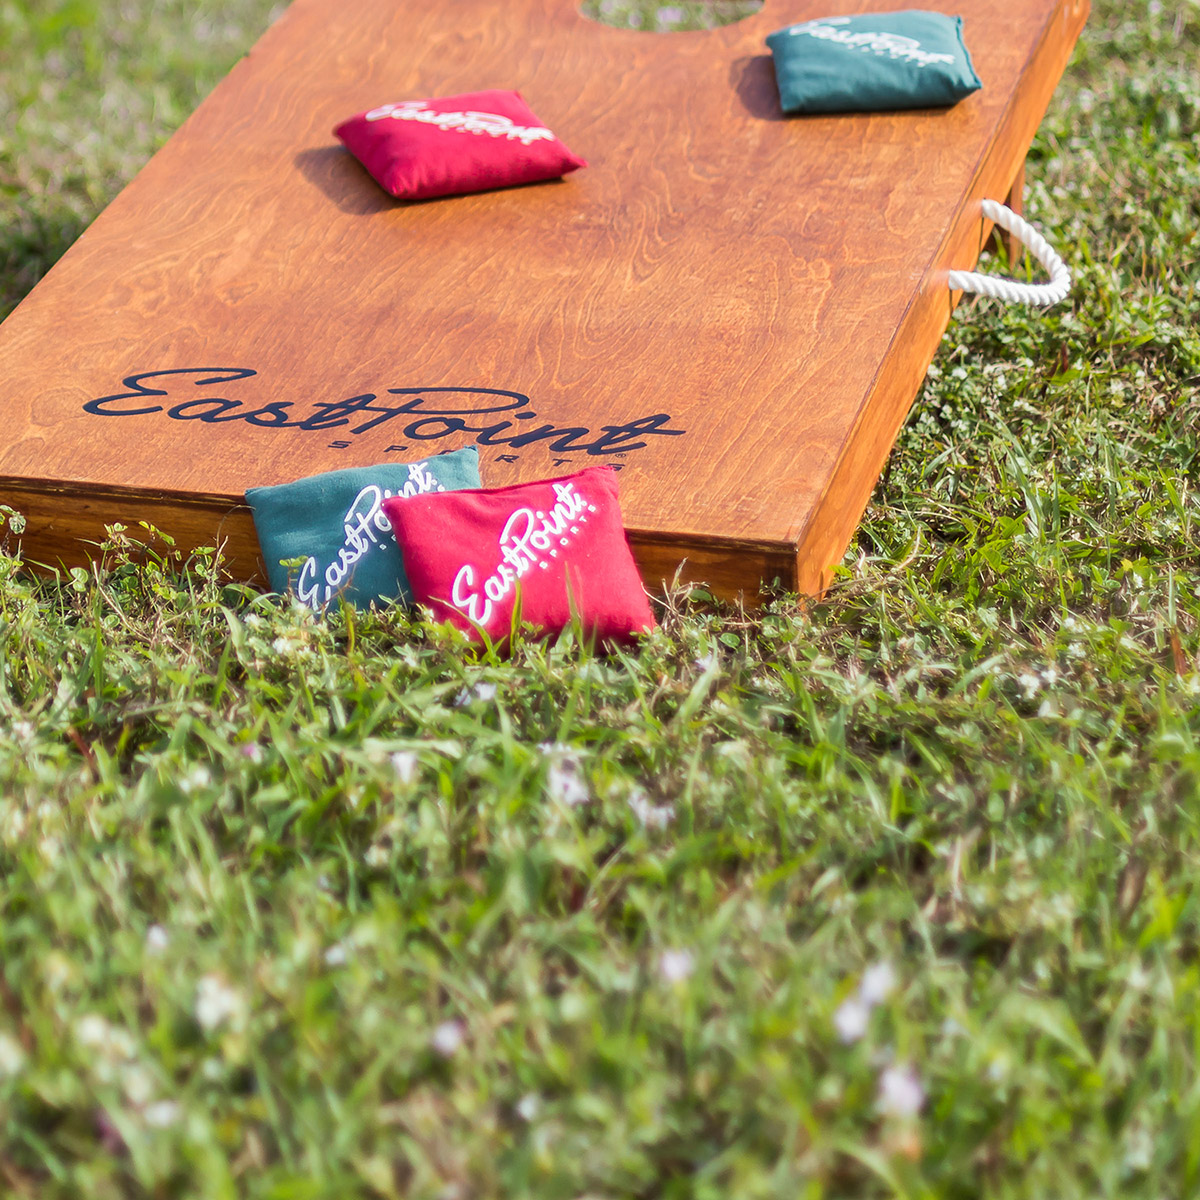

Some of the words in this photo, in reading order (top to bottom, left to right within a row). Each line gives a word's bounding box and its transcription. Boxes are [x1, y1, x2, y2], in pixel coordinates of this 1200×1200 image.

[82, 367, 686, 456] EastPoint
[327, 440, 625, 472] SPRTS
[452, 483, 582, 626] EastPoint
[539, 504, 596, 569] SPORTS
